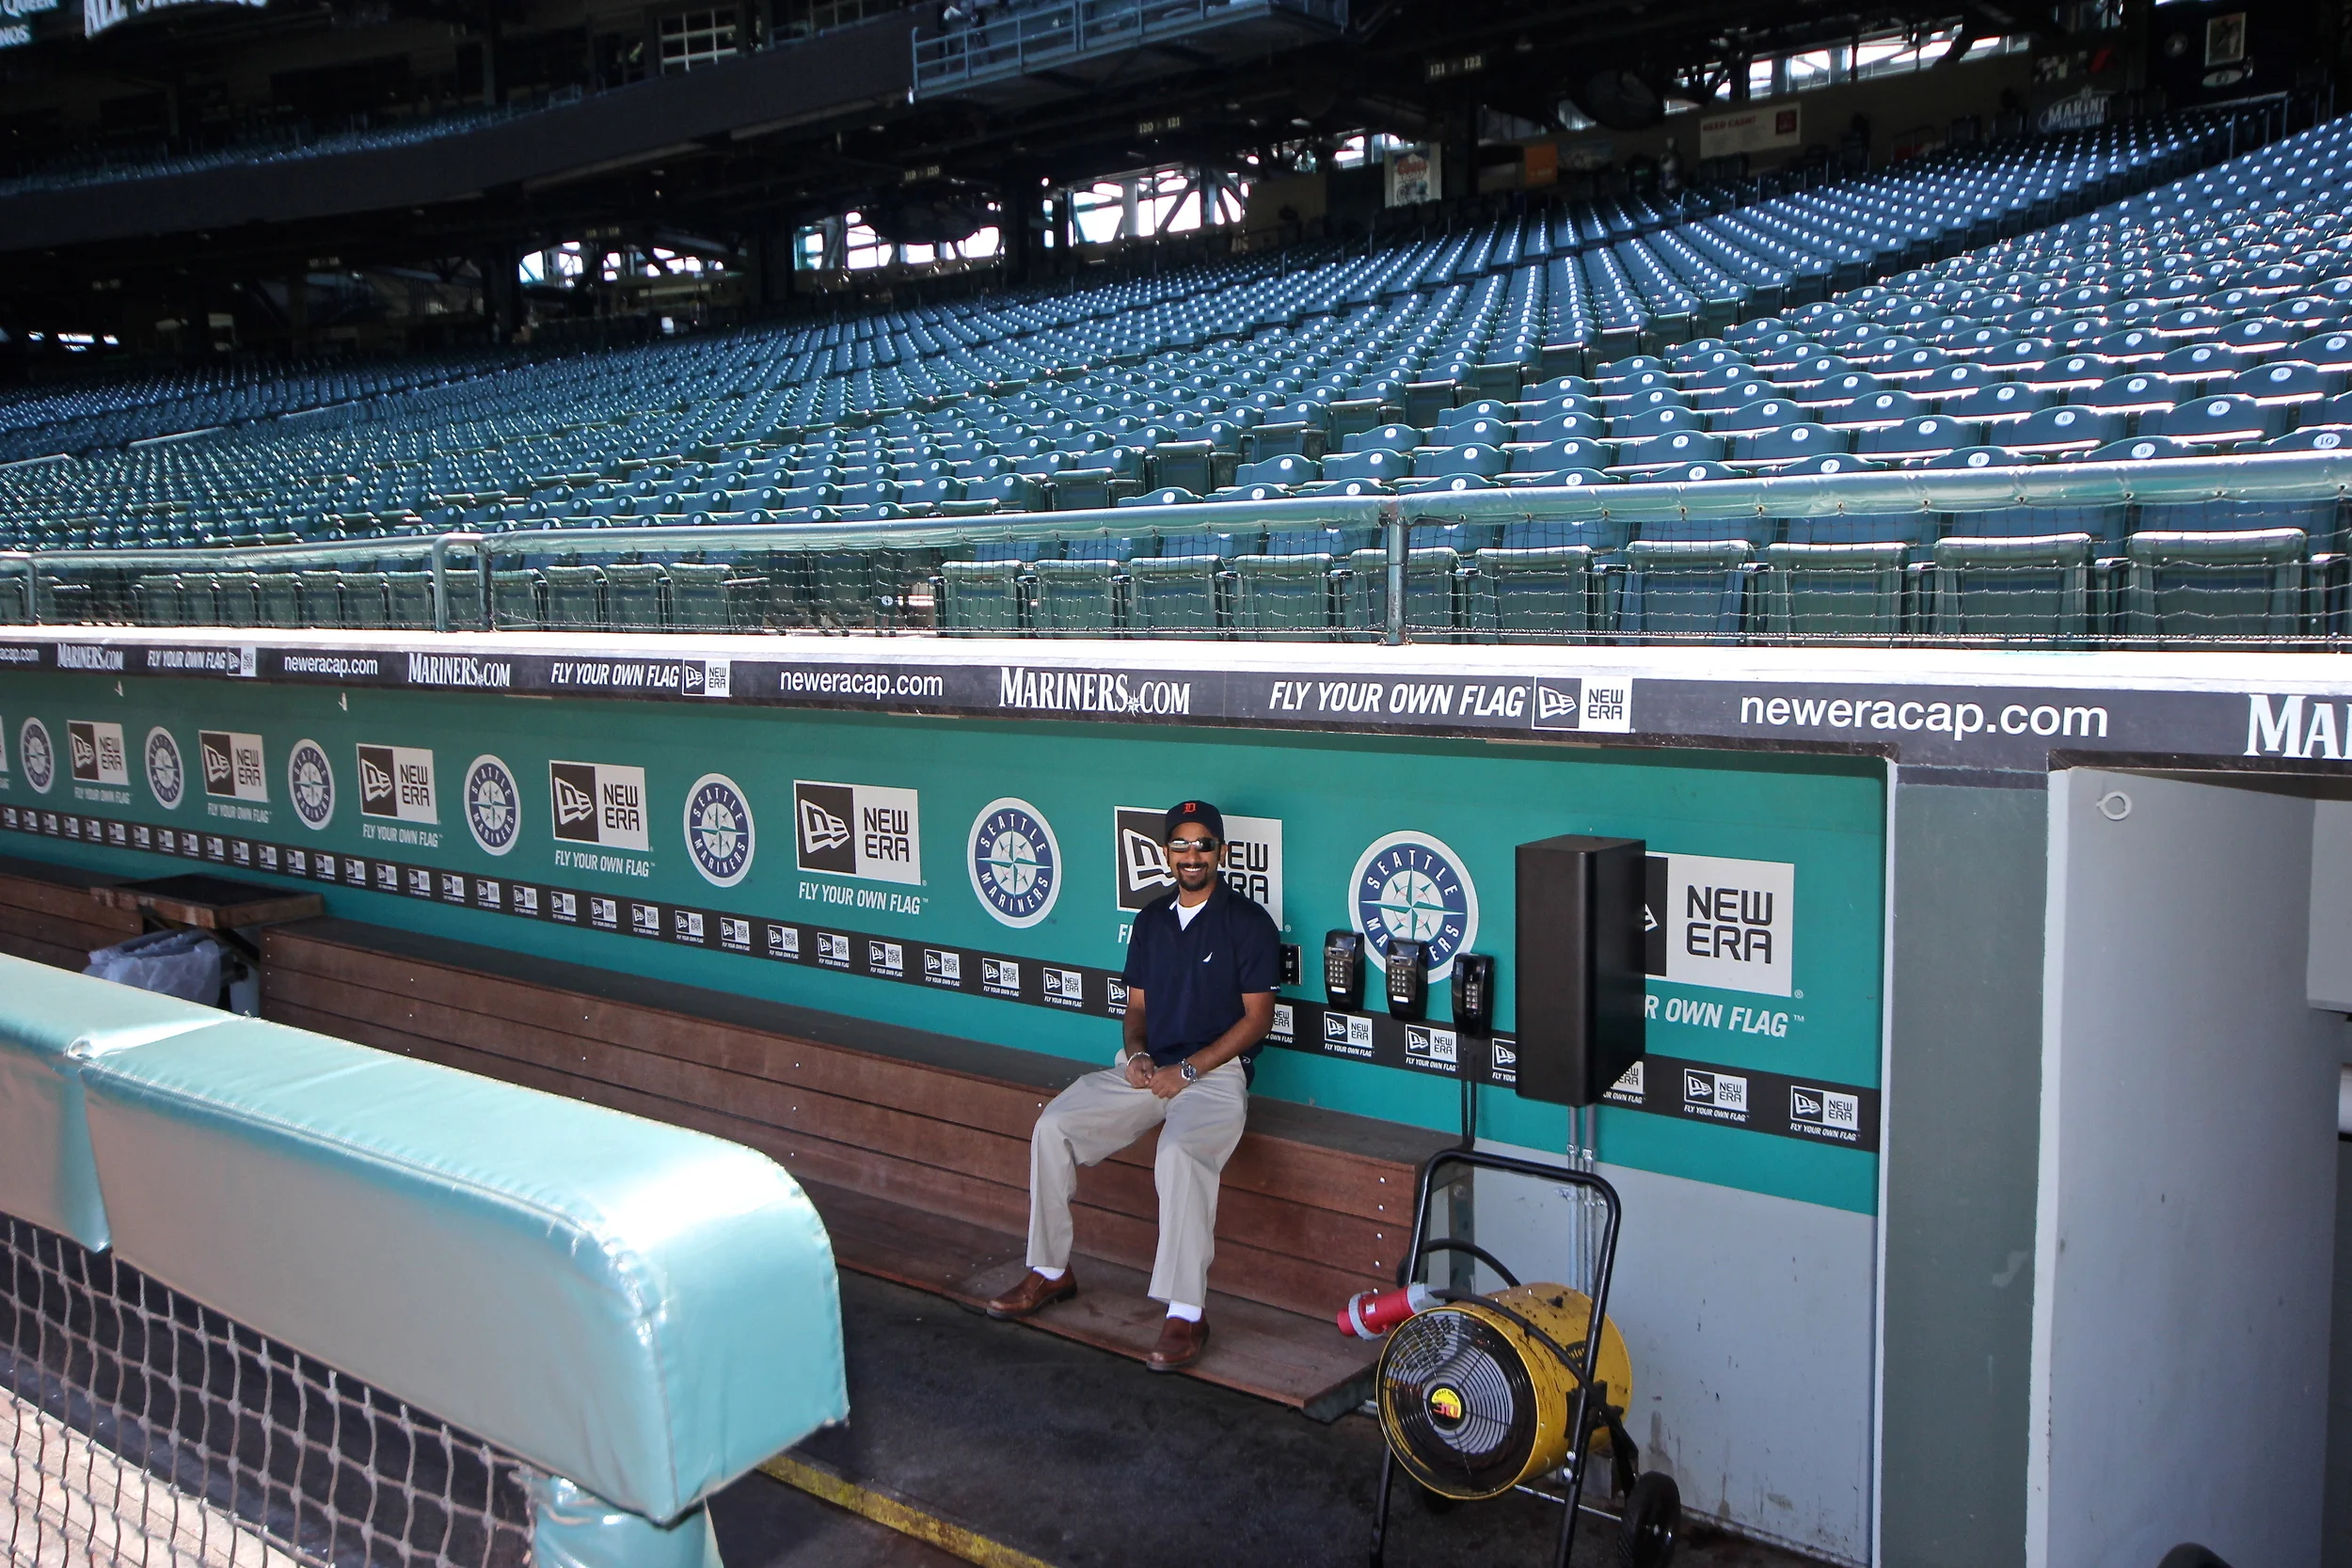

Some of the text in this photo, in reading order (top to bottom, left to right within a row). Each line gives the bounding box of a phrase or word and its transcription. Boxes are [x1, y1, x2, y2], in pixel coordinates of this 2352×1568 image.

[148, 650, 226, 670] FLY YOUR OWN FLAG
[284, 654, 378, 677] neweracap.com
[551, 662, 679, 688] FLY YOUR OWN FLAG
[708, 666, 726, 678] NEW
[708, 677, 726, 689] ERA
[780, 670, 944, 701] neweracap.com
[1269, 681, 1525, 719] FLY YOUR OWN FLAG
[1588, 688, 1624, 705] NEW
[1587, 703, 1623, 720] ERA
[1740, 695, 2107, 741] neweracap.com
[100, 736, 119, 752] NEW
[102, 754, 122, 770] ERA
[236, 748, 259, 768] NEW
[237, 768, 262, 786] ERA
[400, 764, 427, 785] NEW
[471, 767, 511, 797] SEATTLE
[402, 785, 430, 806] ERA
[603, 784, 638, 807] NEW
[693, 787, 743, 821] SEATTLE
[208, 803, 219, 816] FLY
[219, 804, 236, 818] YOUR
[237, 807, 252, 820] OWN
[1184, 802, 1196, 814] D
[473, 813, 514, 844] MARINERS
[605, 807, 640, 831] ERA
[864, 807, 908, 835] NEW
[363, 824, 438, 847] FLY YOUR OWN FLAG
[979, 813, 1047, 853] SEATTLE
[694, 839, 746, 874] MARINERS
[865, 834, 910, 863] ERA
[1222, 840, 1268, 873] EW
[555, 849, 649, 878] FLY YOUR OWN FLAG
[1367, 849, 1458, 895] SEATTLE
[799, 882, 921, 914] FLY YOUR OWN FLAG
[982, 871, 1049, 914] MARINERS
[1686, 884, 1773, 926] NEW
[887, 948, 900, 957] NEW
[1686, 923, 1773, 965] ERA
[944, 958, 957, 966] NEW
[1003, 967, 1016, 975] NEW
[1003, 974, 1016, 983] ERA
[1065, 984, 1079, 993] ERA
[1351, 1022, 1369, 1032] NEW
[1661, 998, 1722, 1031] OWN
[1729, 1005, 1788, 1038] FLAG
[1351, 1031, 1369, 1041] ERA
[1434, 1036, 1453, 1046] NEW
[1434, 1044, 1453, 1055] ERA
[1415, 1058, 1429, 1068] YOUR
[1430, 1061, 1442, 1069] OWN
[1719, 1082, 1741, 1093] NEW
[1720, 1091, 1741, 1102] ERA
[1684, 1104, 1746, 1122] FLY YOUR OWN FLAG
[1828, 1100, 1852, 1111] NEW
[1828, 1110, 1852, 1122] ERA
[1790, 1122, 1857, 1142] FLY YOUR OWN FLAG
